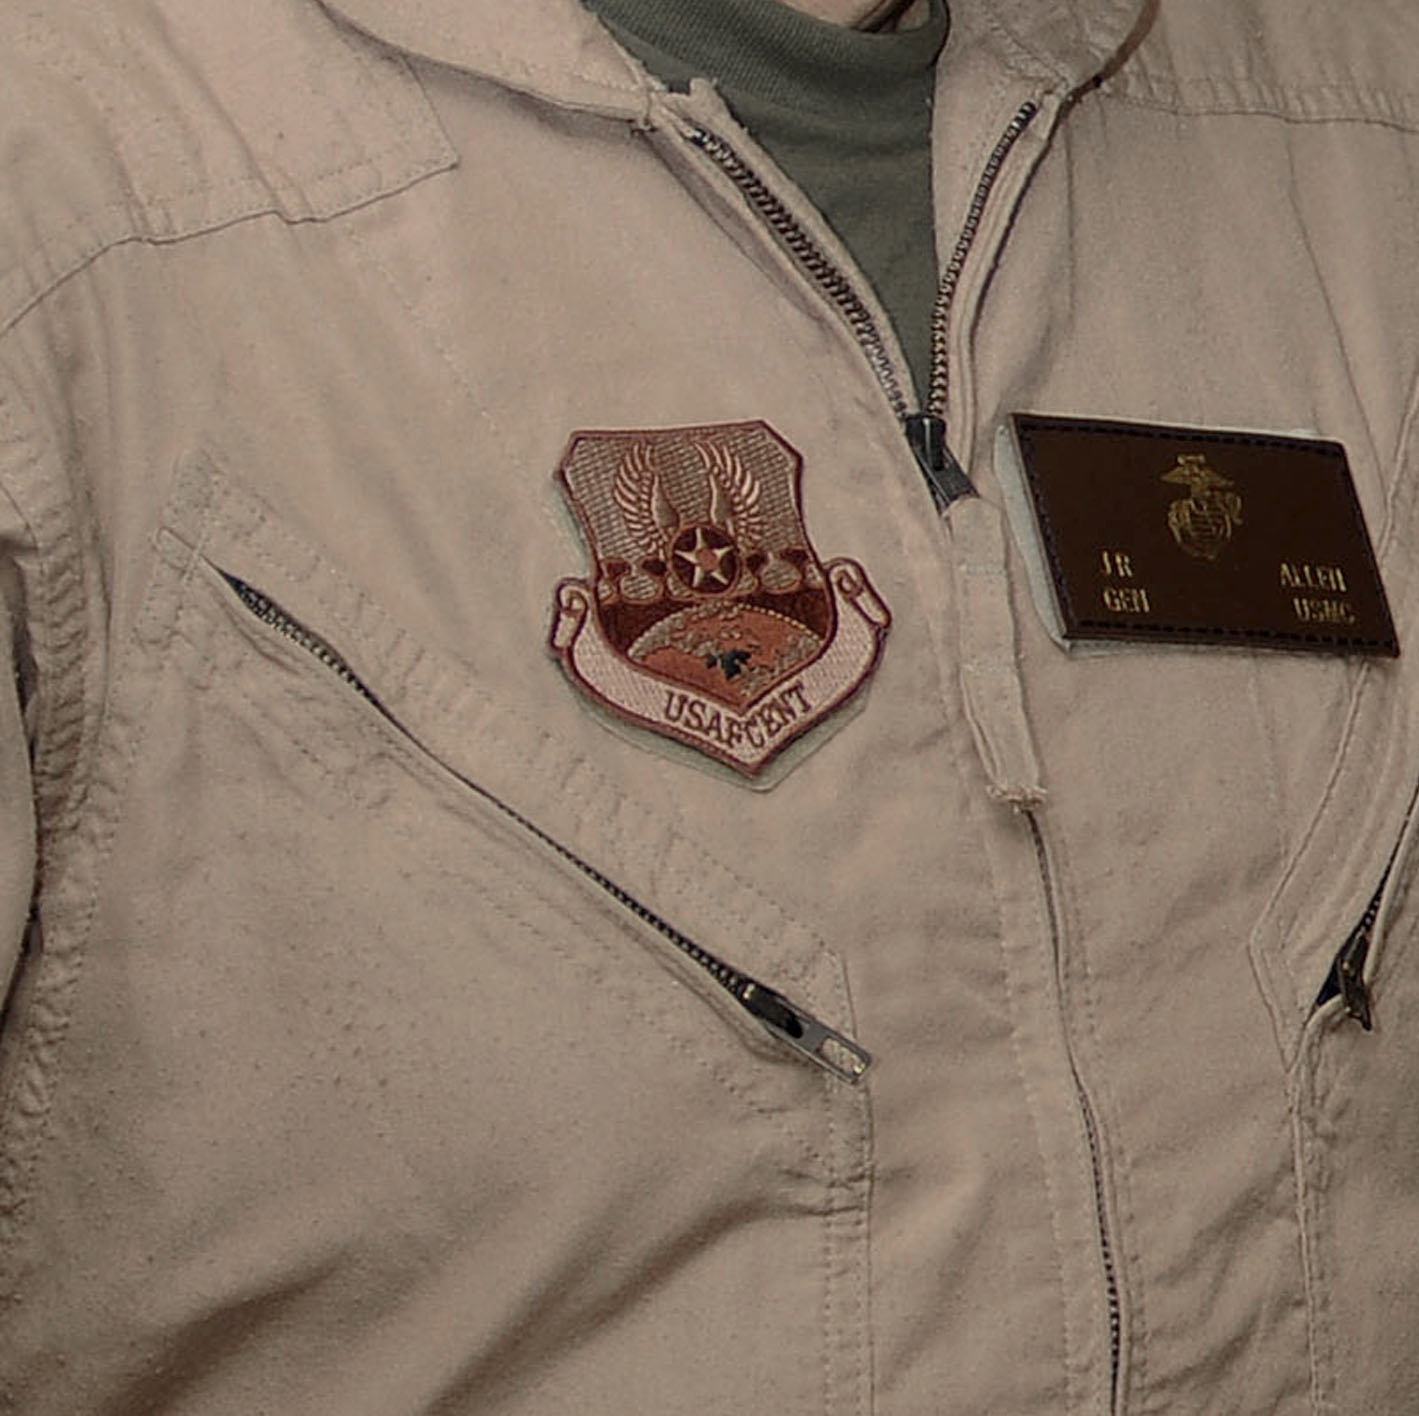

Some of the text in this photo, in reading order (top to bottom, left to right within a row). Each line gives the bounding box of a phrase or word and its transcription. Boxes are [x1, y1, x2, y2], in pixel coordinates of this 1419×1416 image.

[1280, 562, 1348, 593] ALLEN
[1292, 597, 1357, 624] USMC
[663, 683, 814, 749] USAFCENT
